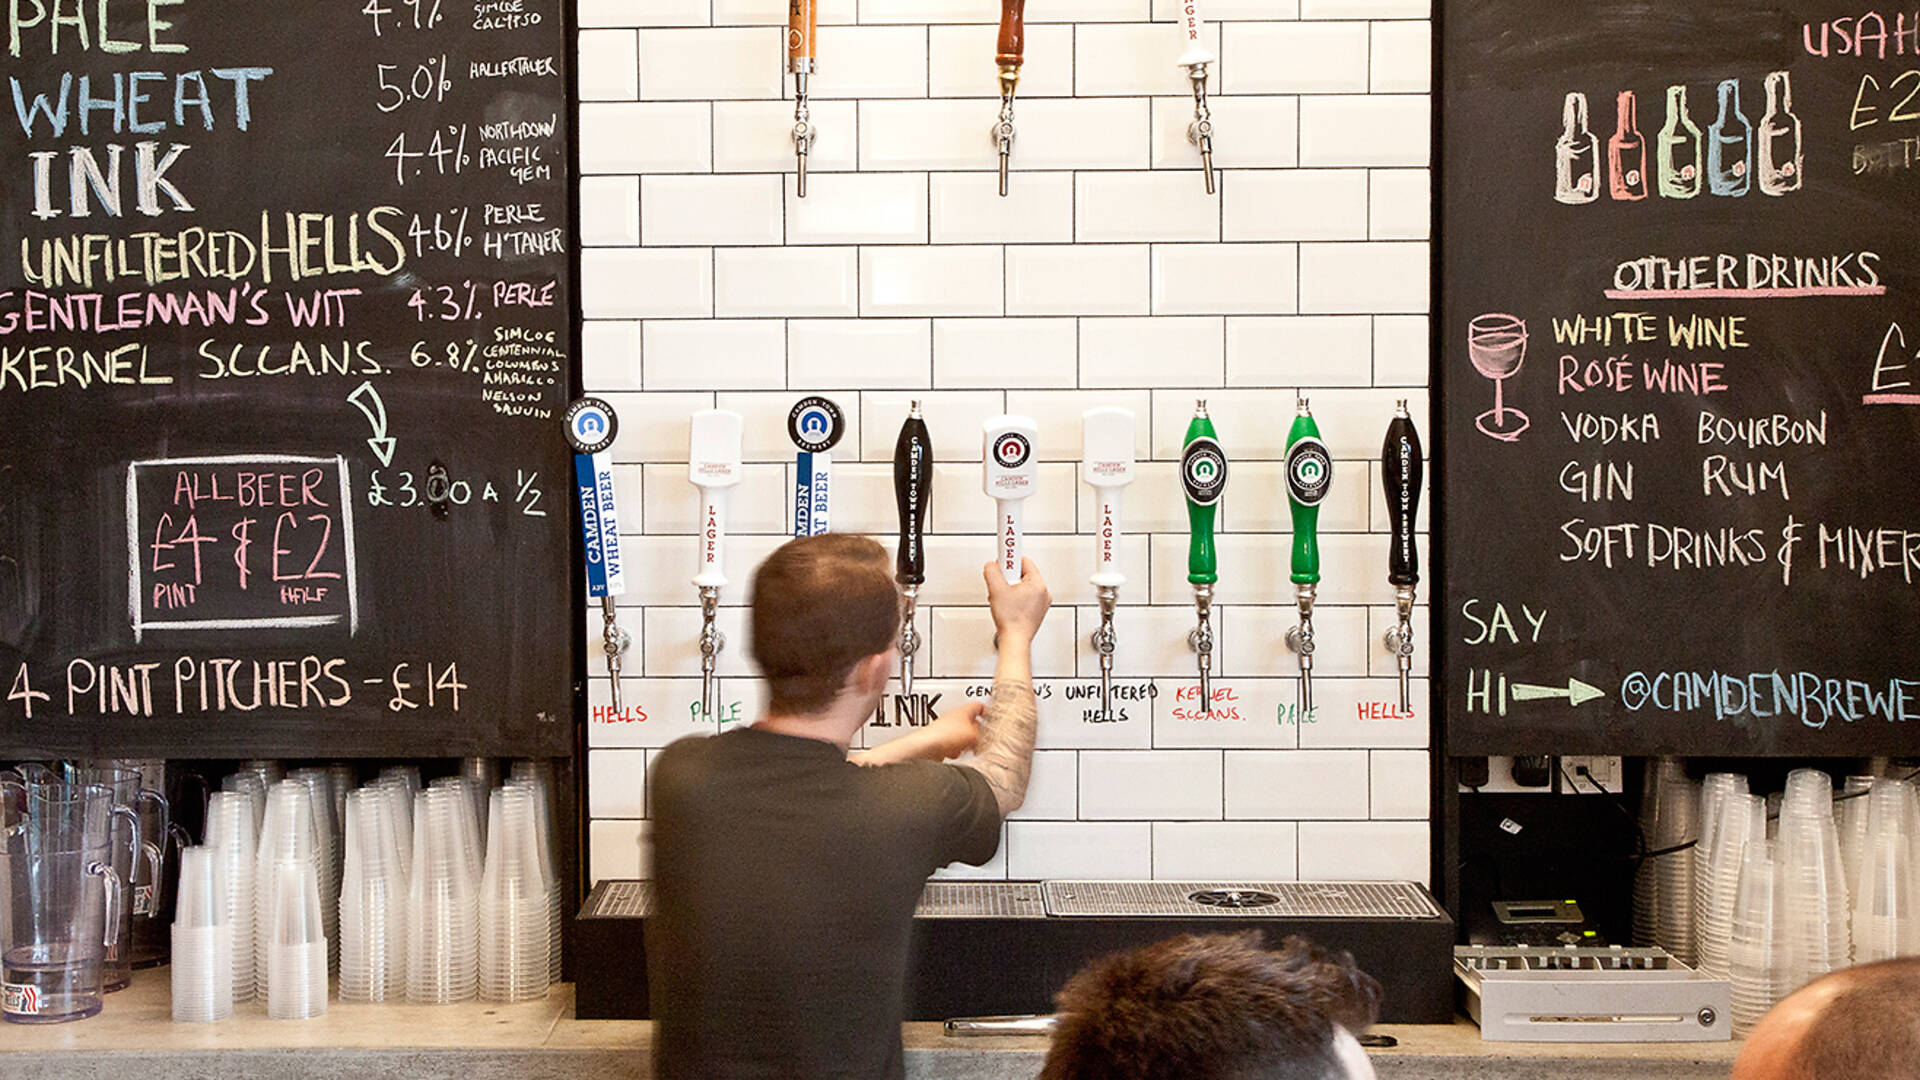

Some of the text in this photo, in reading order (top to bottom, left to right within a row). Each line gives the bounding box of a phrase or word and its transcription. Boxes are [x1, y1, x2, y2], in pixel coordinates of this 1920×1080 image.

[9, 0, 190, 58] PALE
[472, 13, 542, 30] CALYPSO
[9, 67, 274, 139] WHEAT
[377, 54, 452, 112] 5.0%
[479, 113, 557, 142] NORTHDOWN
[384, 123, 470, 185] 4.4%
[480, 146, 541, 169] PACIFIC
[28, 141, 196, 220] INK
[408, 207, 472, 257] 4.6%
[484, 203, 545, 225] PERLE
[21, 206, 407, 289] UNFILTERED HELLS
[1613, 252, 1880, 292] OTHER DRINKS
[0, 281, 362, 336] GENTLEMAN'S WIT
[407, 279, 482, 321] 4.3%
[493, 280, 556, 308] PERLE
[482, 344, 567, 358] CENTENNIAL
[494, 326, 556, 343] SIMCOE
[1552, 312, 1750, 350] WHITE WINE
[0, 343, 173, 392] KERNEL
[485, 359, 560, 372] COLUMBUS
[1558, 353, 1729, 396] ROSÉ WINE
[482, 388, 542, 401] NELSON
[1560, 409, 1827, 449] VODKA BOURBON
[174, 468, 329, 510] ALL BEER
[600, 471, 616, 512] BEER
[815, 472, 828, 512] BEER
[1559, 454, 1789, 502] GIN RUM
[581, 486, 602, 563] CAMDEN
[706, 505, 717, 563] LAGER
[1005, 514, 1015, 570] LAGER
[1102, 504, 1113, 562] LAGER
[150, 512, 218, 585] £4
[272, 512, 342, 581] £2
[603, 517, 621, 578] WHEAT
[1560, 518, 1639, 569] SOFT
[1648, 522, 1767, 570] DRINKS
[1819, 523, 1920, 584] MIXER
[153, 582, 329, 609] PINT HALF
[1462, 599, 1547, 644] SAY
[7, 662, 50, 719] 4
[67, 658, 161, 717] PINT
[174, 655, 352, 714] PITCHERS
[1065, 683, 1159, 702] UNFITERED
[1466, 668, 1507, 716] HI
[593, 705, 648, 724] HELLS
[869, 692, 942, 727] INK
[1083, 708, 1129, 724] HELLS
[1357, 701, 1415, 721] HELLS
